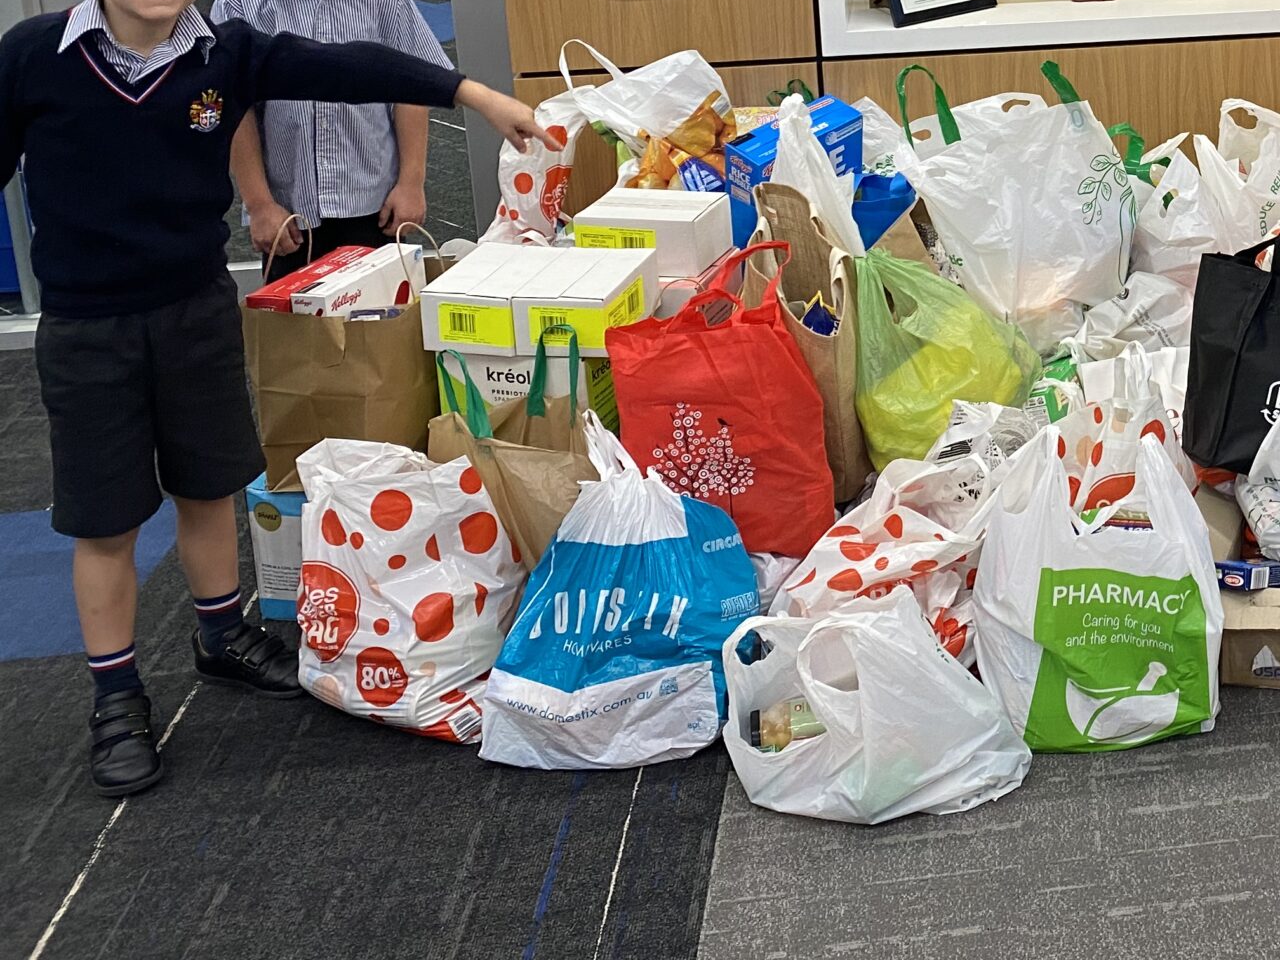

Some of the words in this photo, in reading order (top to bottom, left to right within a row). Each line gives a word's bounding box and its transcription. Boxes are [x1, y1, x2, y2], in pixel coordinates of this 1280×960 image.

[731, 166, 751, 182] RICE
[1260, 200, 1276, 238] EDUCE
[331, 289, 362, 311] Kellogg's
[1052, 583, 1190, 616] PHARMACY
[1082, 613, 1120, 629] Caring
[1124, 615, 1138, 629] for
[1141, 621, 1161, 636] you
[1065, 632, 1086, 647] and
[1089, 630, 1107, 644] the
[360, 667, 400, 690] 80%
[506, 689, 654, 724] www.domestix.com.au
